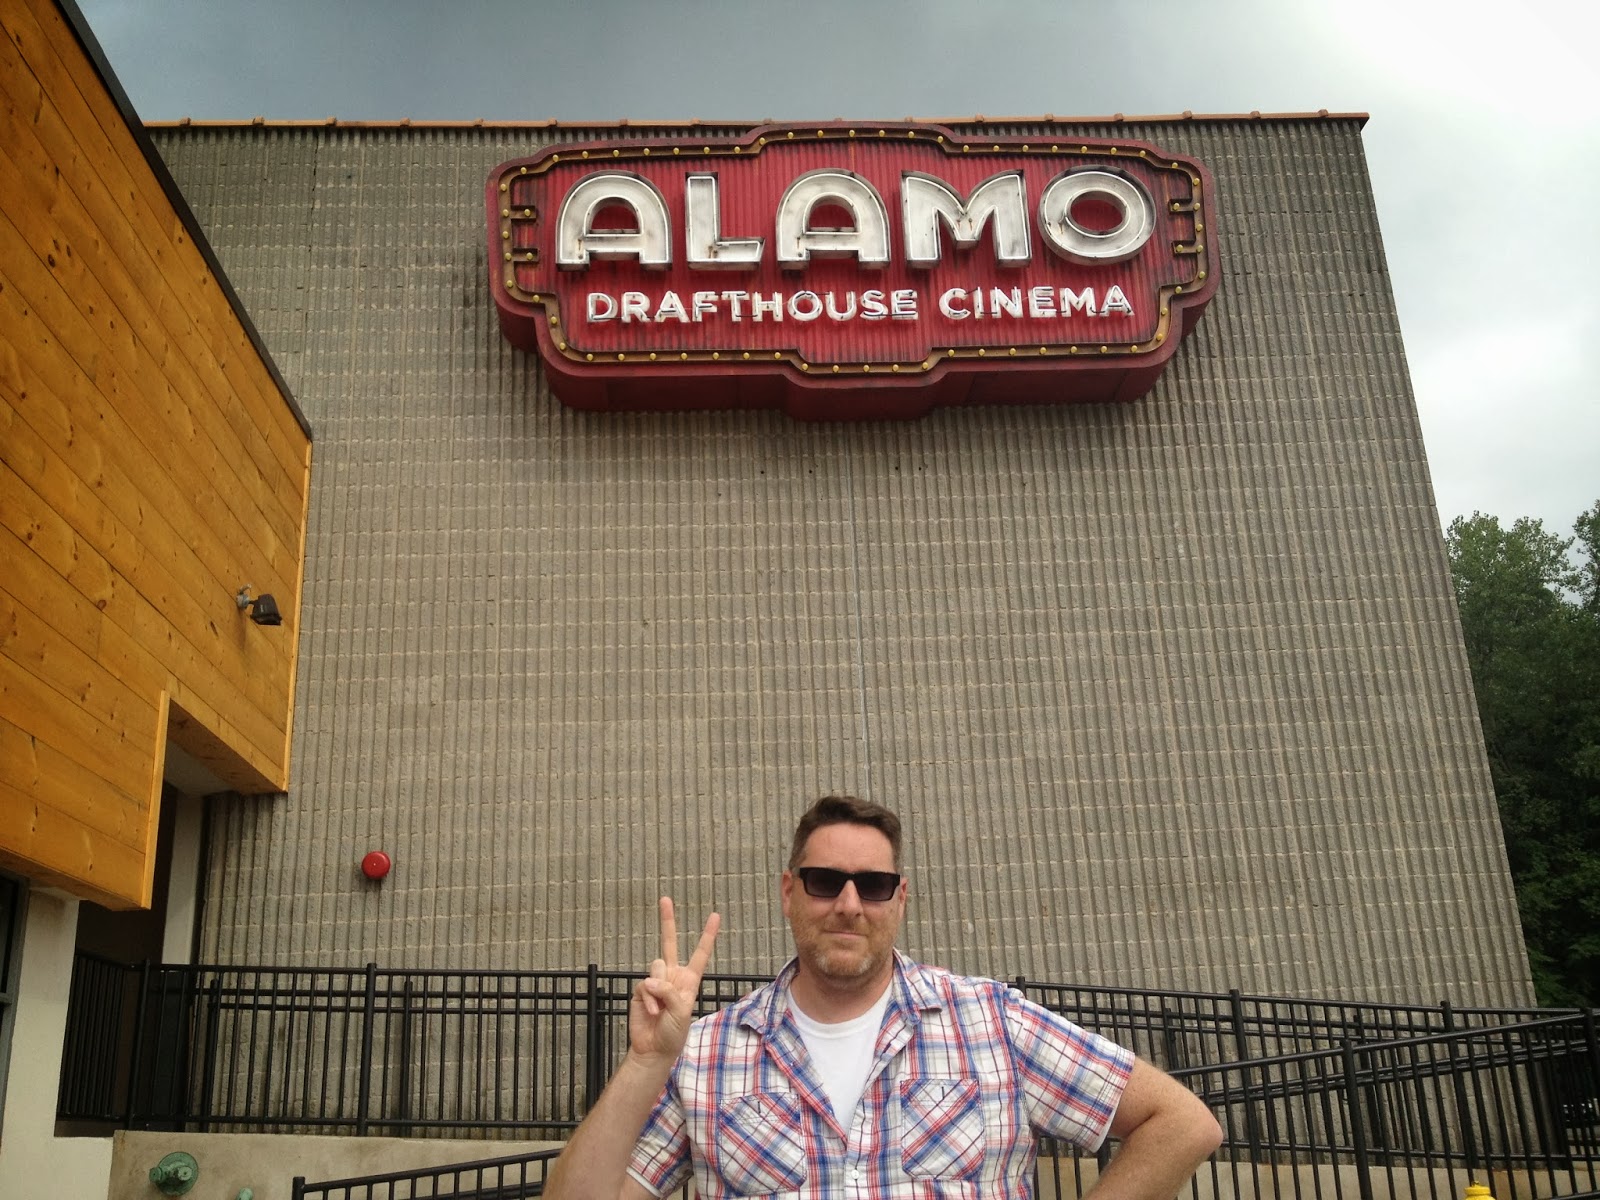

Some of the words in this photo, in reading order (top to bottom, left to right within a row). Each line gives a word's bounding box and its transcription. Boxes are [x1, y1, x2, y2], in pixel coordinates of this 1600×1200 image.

[556, 165, 1156, 270] ALAMO
[586, 289, 918, 323] DRAFTHOUSE
[938, 285, 1135, 320] CINEMA
